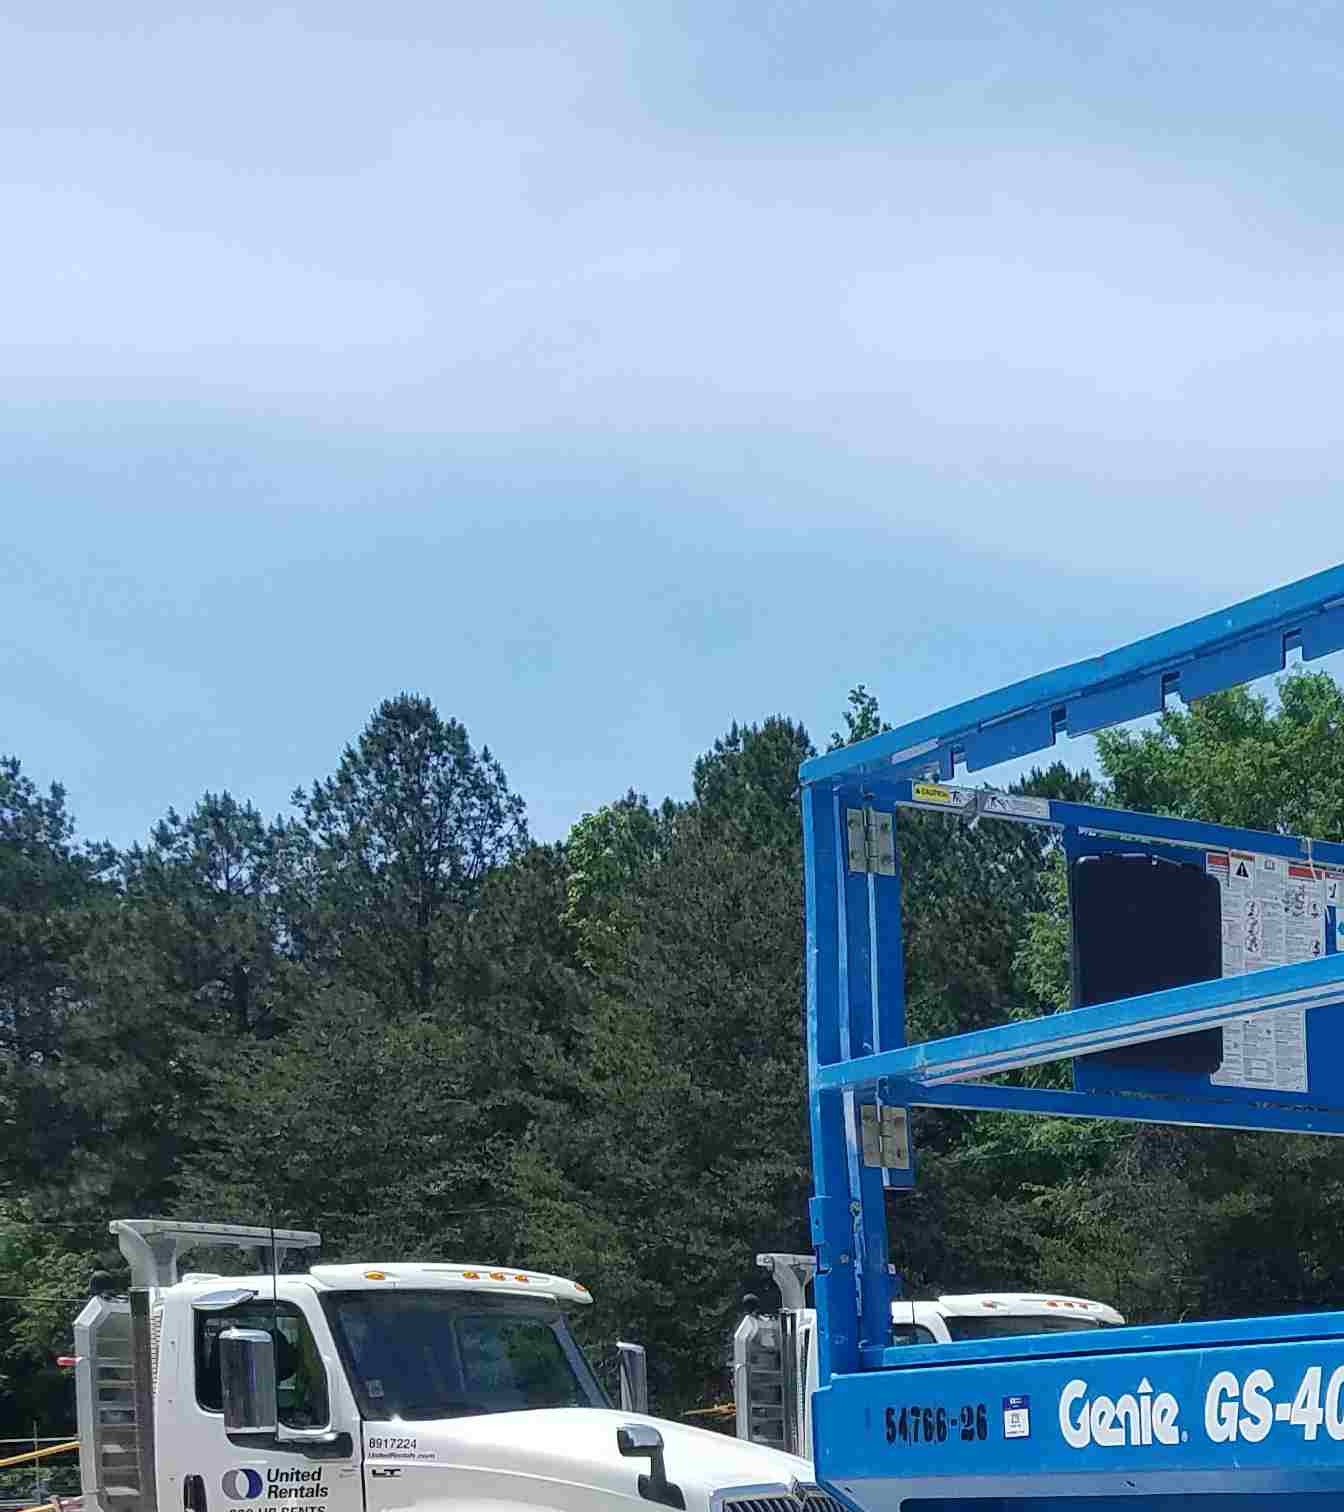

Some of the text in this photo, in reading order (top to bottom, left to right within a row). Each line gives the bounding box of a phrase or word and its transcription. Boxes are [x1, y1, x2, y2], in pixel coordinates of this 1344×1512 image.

[885, 1404, 988, 1443] 54766-26
[1058, 1376, 1184, 1449] Genie
[267, 1467, 322, 1483] United
[267, 1483, 329, 1500] Rentals
